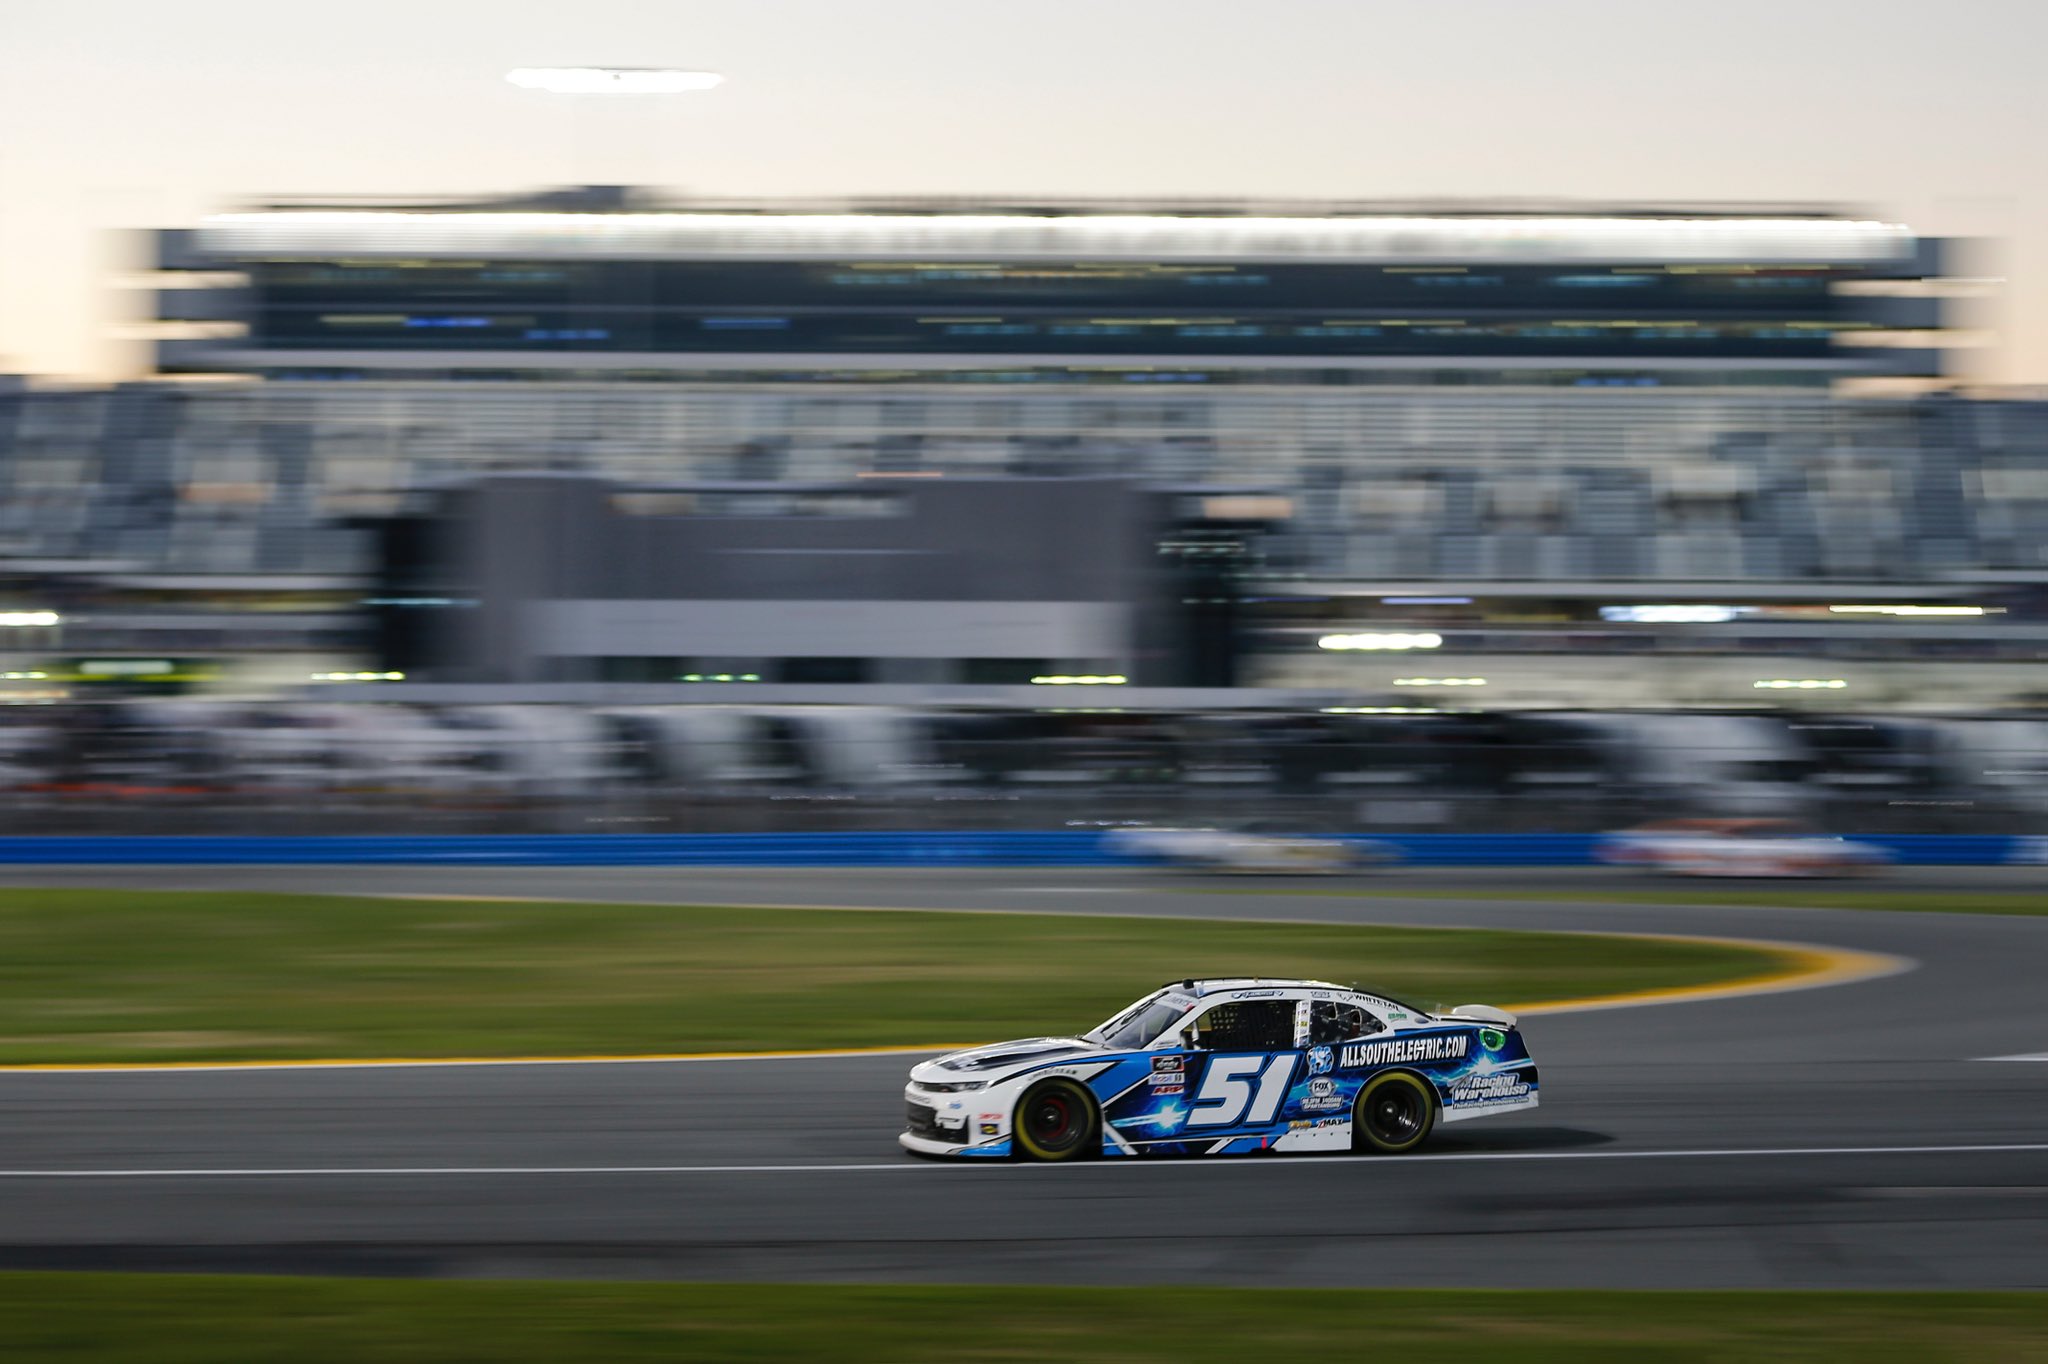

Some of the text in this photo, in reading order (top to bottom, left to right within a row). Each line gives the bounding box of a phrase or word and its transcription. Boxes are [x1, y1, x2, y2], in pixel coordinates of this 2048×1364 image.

[1340, 1036, 1467, 1068] ALLSOUTHELECTRIC.COM
[1186, 1054, 1297, 1126] 51
[1314, 1082, 1329, 1090] FOX
[1471, 1075, 1516, 1089] Racing
[1454, 1084, 1529, 1100] Warehouse
